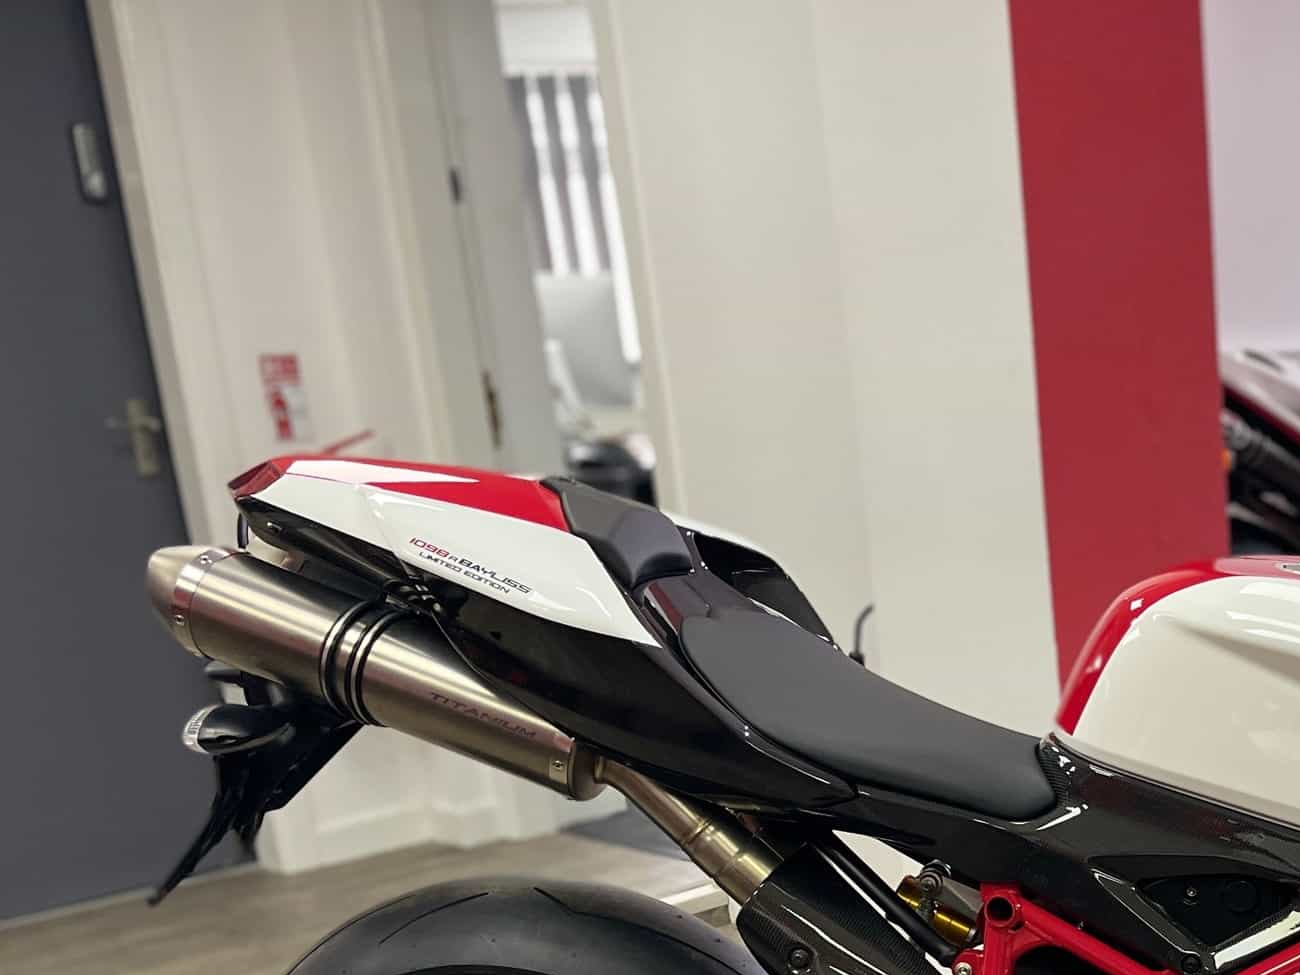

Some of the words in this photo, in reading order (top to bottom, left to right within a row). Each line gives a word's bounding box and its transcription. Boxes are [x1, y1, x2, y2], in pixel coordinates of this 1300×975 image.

[418, 551, 463, 573] LIMITED
[463, 571, 510, 595] EDITION
[459, 558, 532, 594] BAYLISS
[430, 691, 537, 739] TITANIUM
